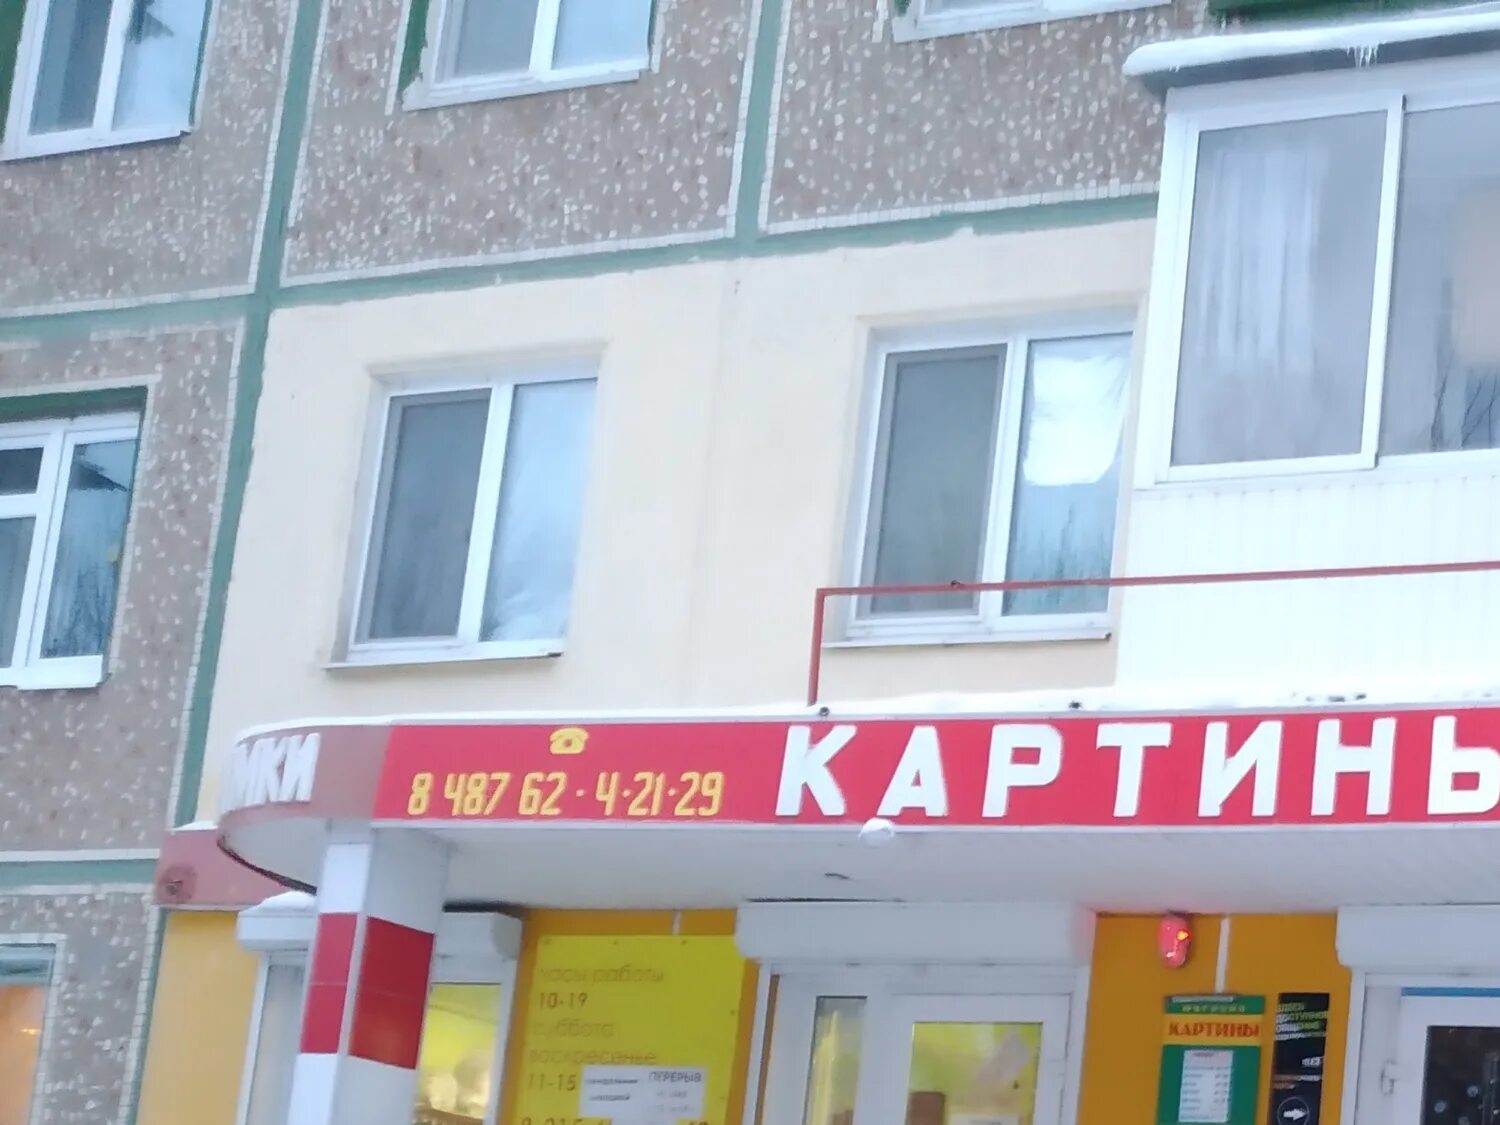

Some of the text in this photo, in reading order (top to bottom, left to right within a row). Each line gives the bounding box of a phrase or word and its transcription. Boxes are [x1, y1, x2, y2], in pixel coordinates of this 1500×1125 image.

[408, 771, 434, 816] 8
[444, 771, 511, 816] 487
[539, 992, 588, 1009] 10-19
[1168, 1021, 1260, 1038] КАРТИНЫ
[527, 1073, 577, 1092] 11-15
